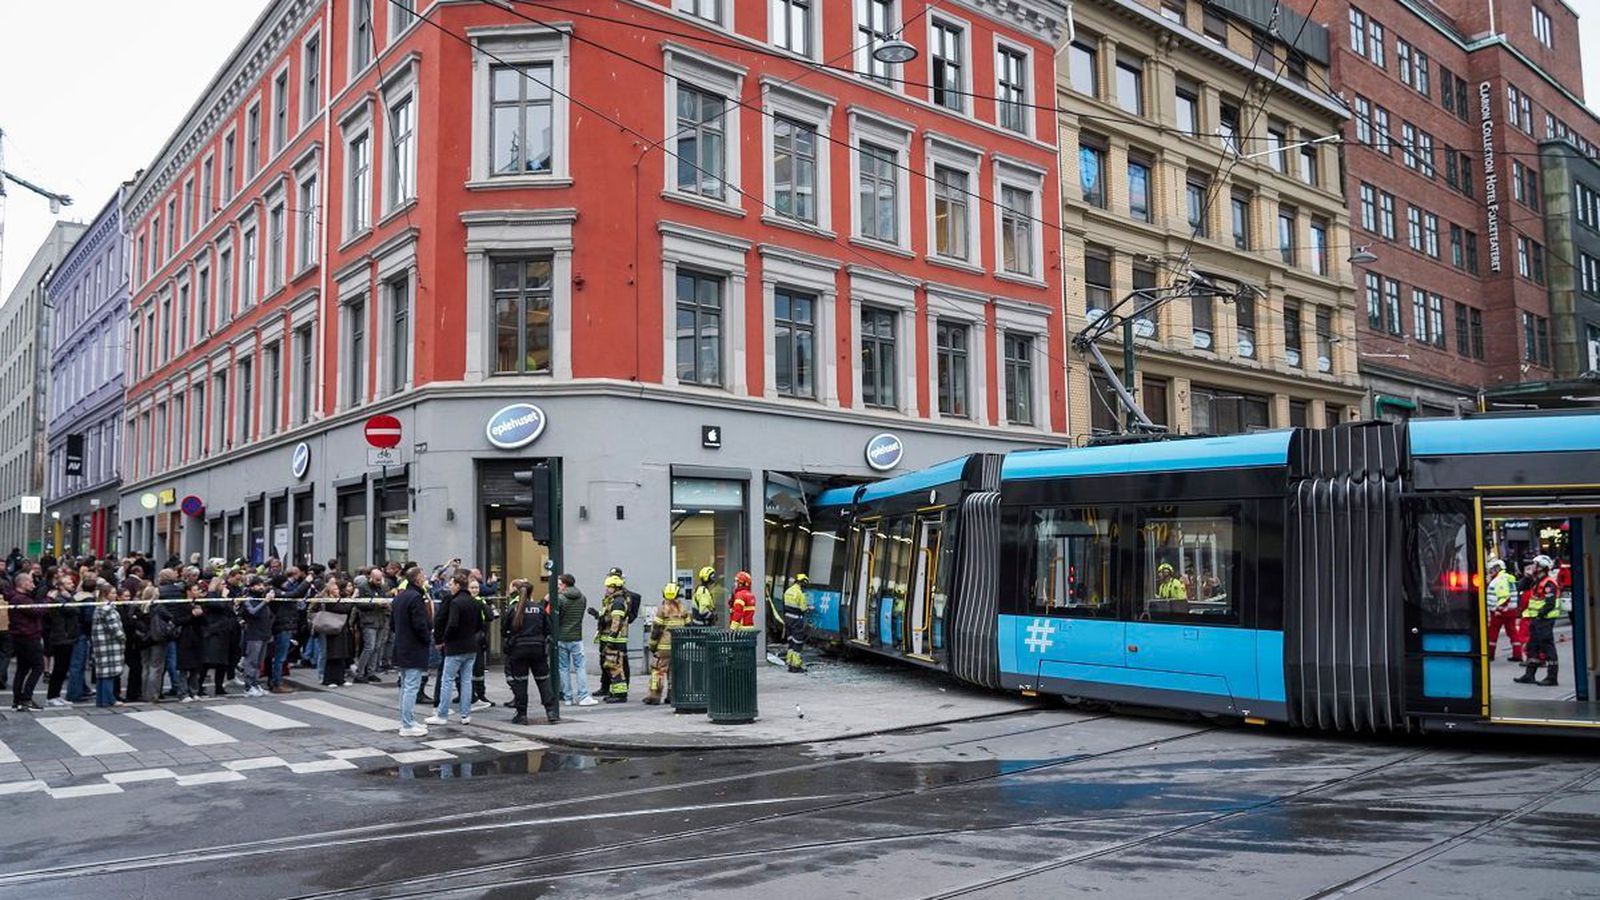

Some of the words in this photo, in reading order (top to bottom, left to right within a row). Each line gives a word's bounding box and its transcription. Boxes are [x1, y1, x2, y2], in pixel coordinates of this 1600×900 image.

[1486, 174, 1497, 205] HOTEL
[491, 411, 539, 436] eplehuset
[870, 441, 899, 459] eplehuset
